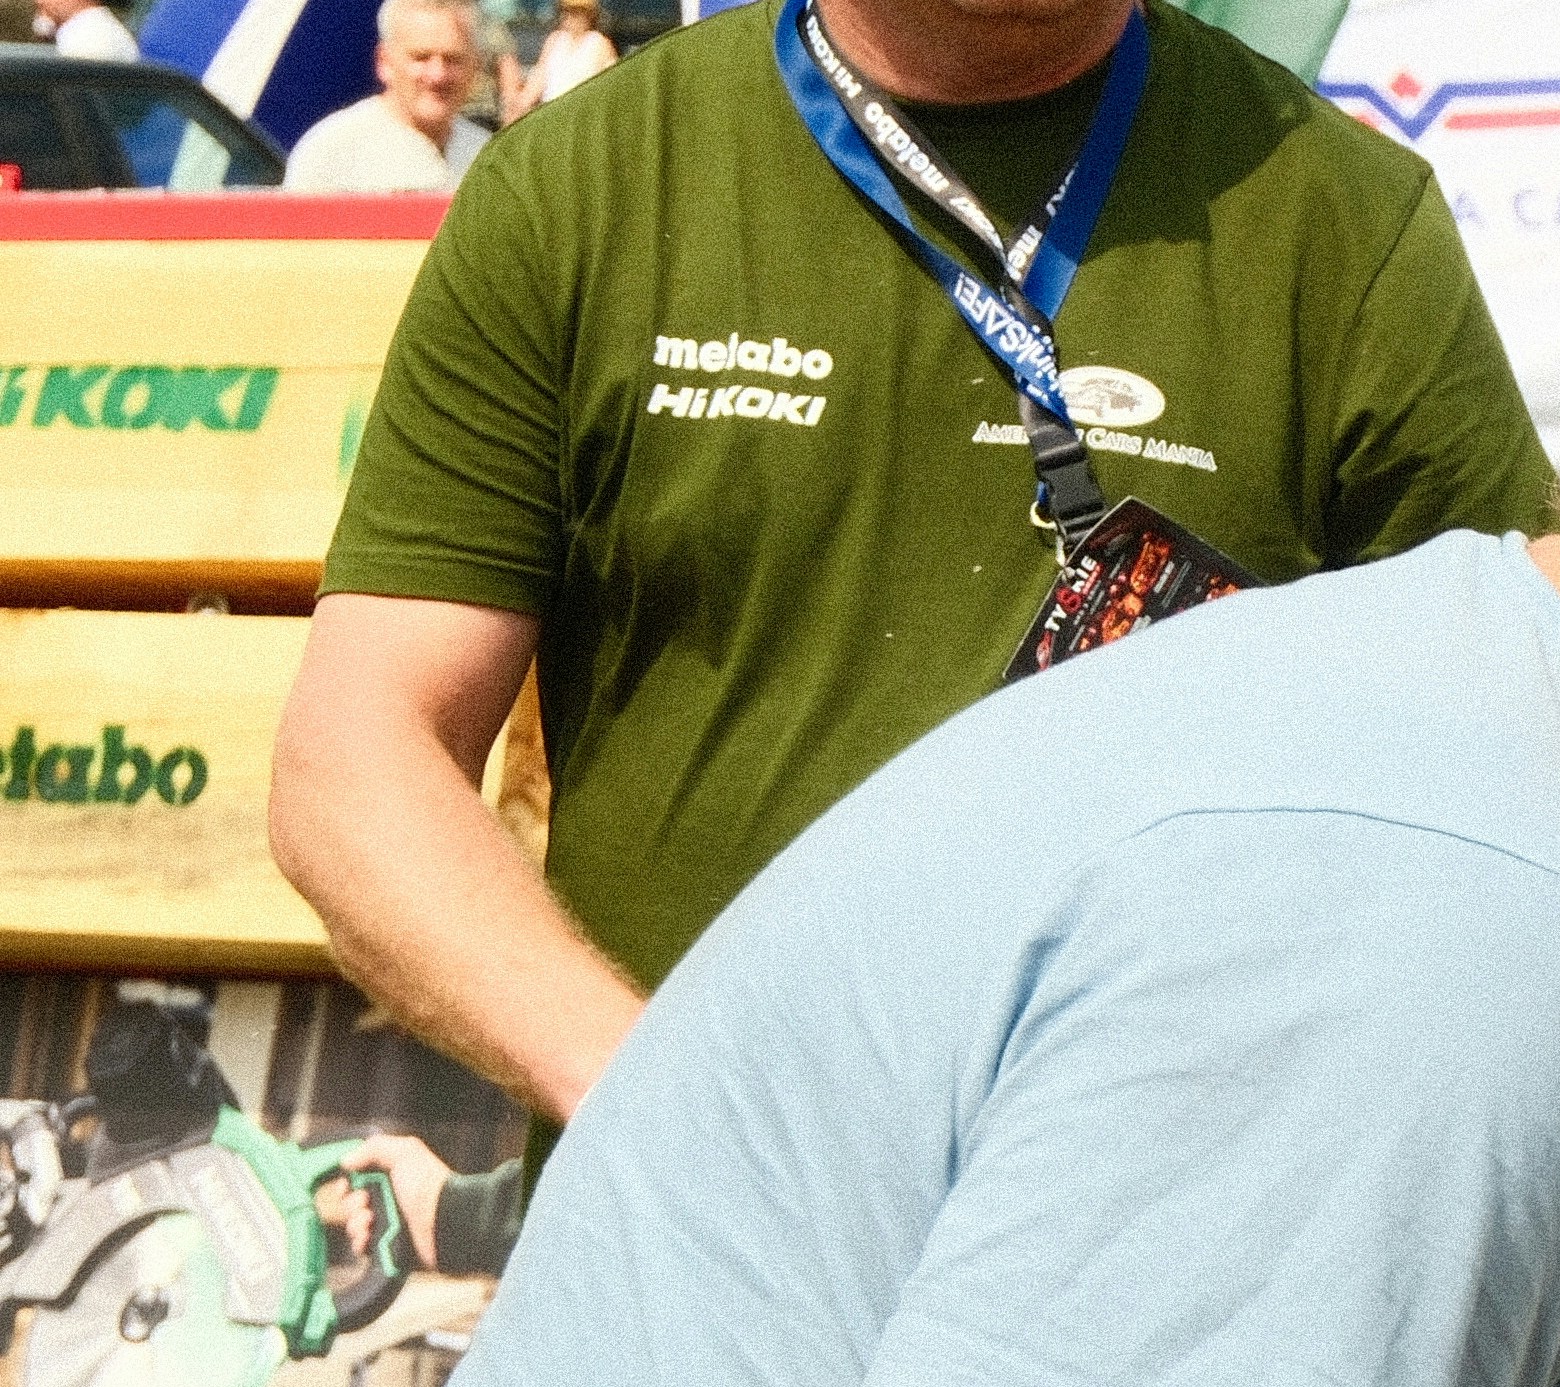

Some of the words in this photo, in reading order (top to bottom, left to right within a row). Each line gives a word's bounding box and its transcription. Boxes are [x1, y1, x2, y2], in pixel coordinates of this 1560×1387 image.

[864, 101, 950, 193] metabo
[652, 331, 834, 380] metabo
[0, 364, 281, 433] iKOKI
[646, 383, 827, 427] HiKOKI
[0, 723, 208, 807] tabo
